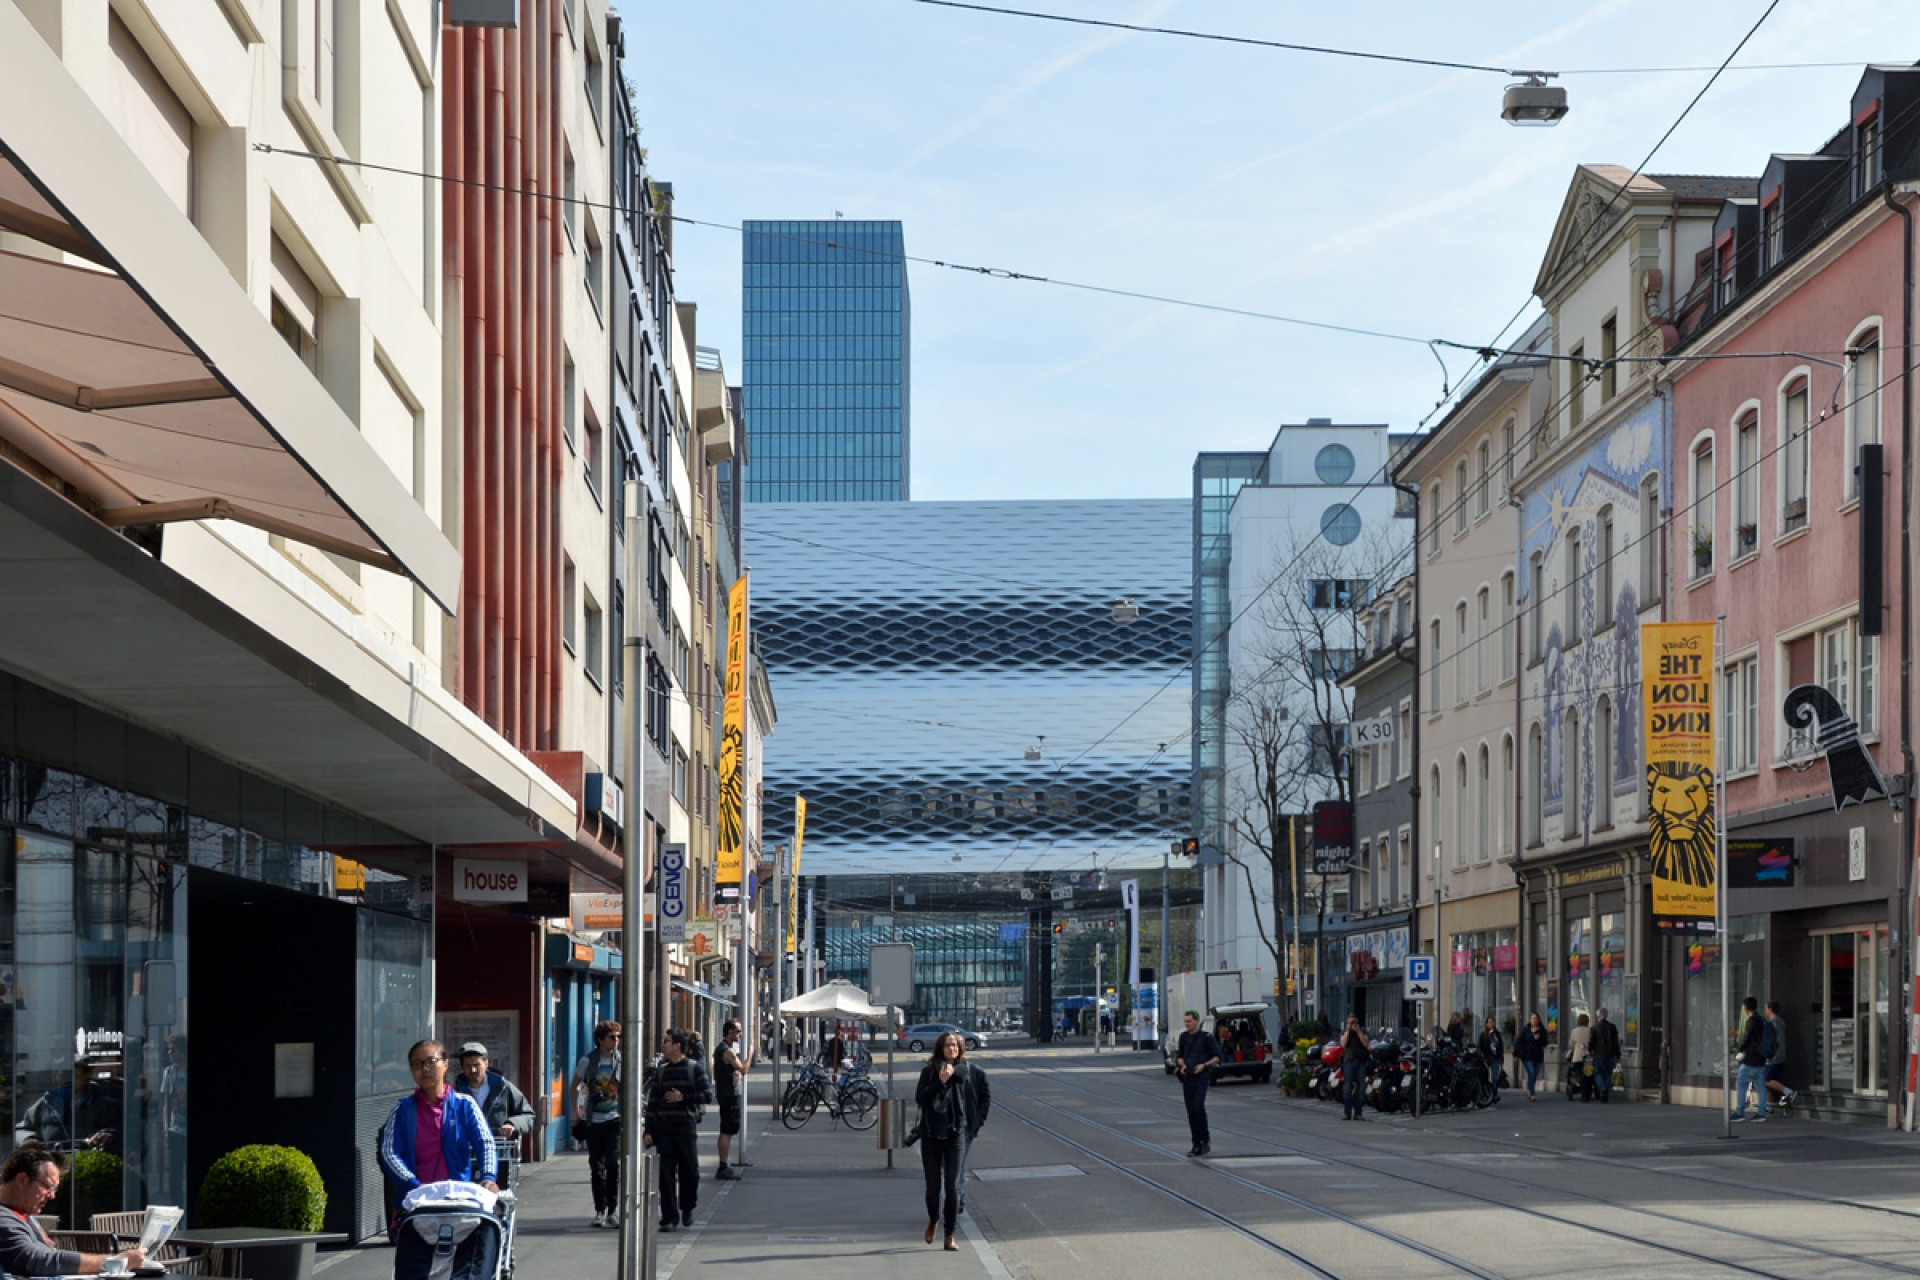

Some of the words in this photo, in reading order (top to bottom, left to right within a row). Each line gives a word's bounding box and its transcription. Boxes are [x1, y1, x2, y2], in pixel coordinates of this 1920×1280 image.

[1357, 725, 1369, 742] K
[1372, 721, 1392, 739] 30
[1315, 845, 1350, 860] night
[463, 866, 518, 892] house
[662, 850, 684, 918] CENCI
[1415, 962, 1425, 978] P
